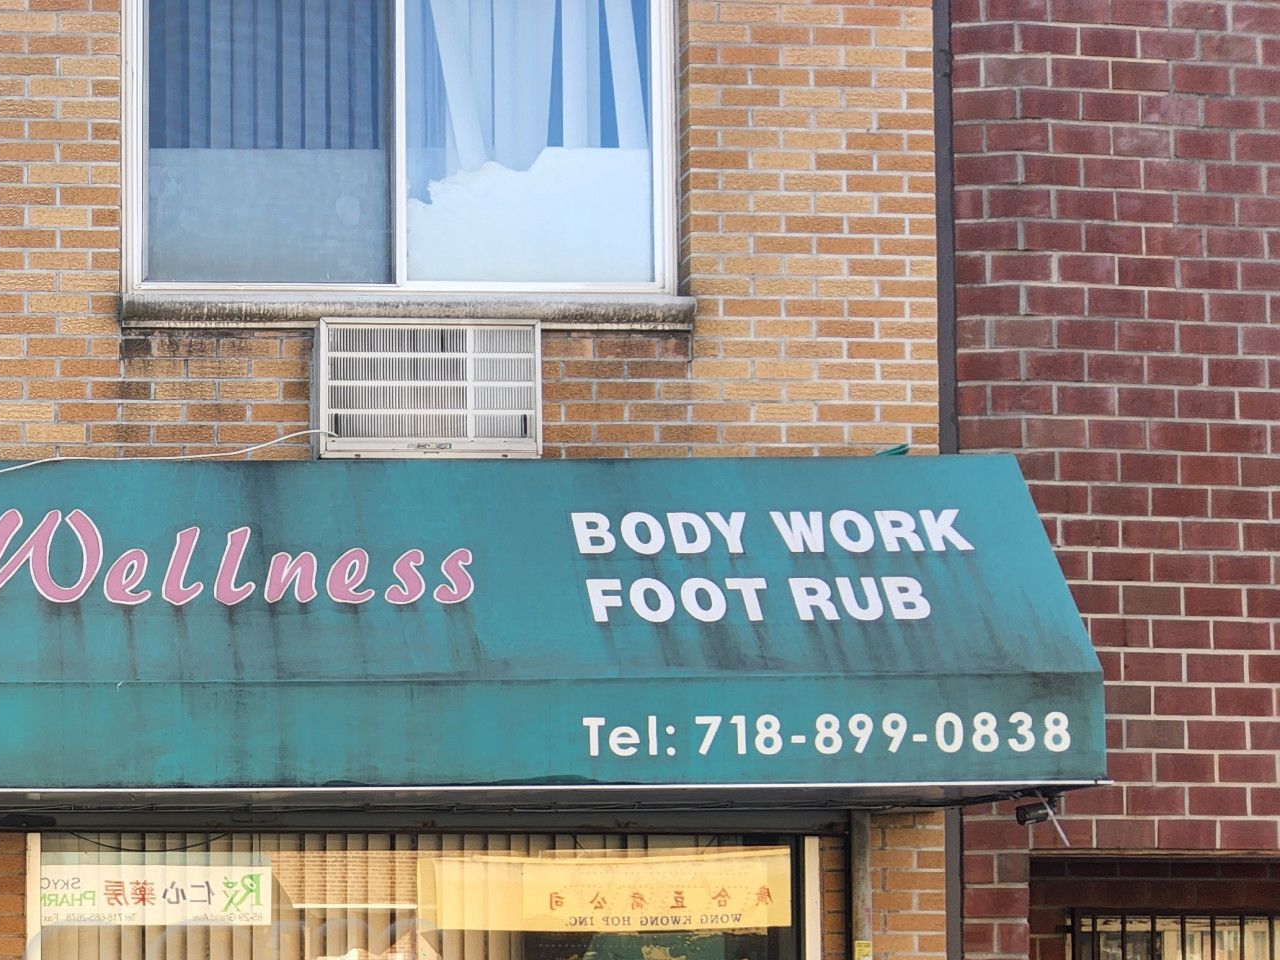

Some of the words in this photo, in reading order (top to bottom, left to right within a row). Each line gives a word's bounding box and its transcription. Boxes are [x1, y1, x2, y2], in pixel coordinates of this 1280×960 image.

[570, 511, 746, 555] BODY
[768, 509, 975, 553] WORK
[585, 577, 767, 623] FOOT
[788, 576, 932, 621] RUB
[582, 716, 676, 757] Tel:
[694, 711, 1071, 756] 718-899-0838
